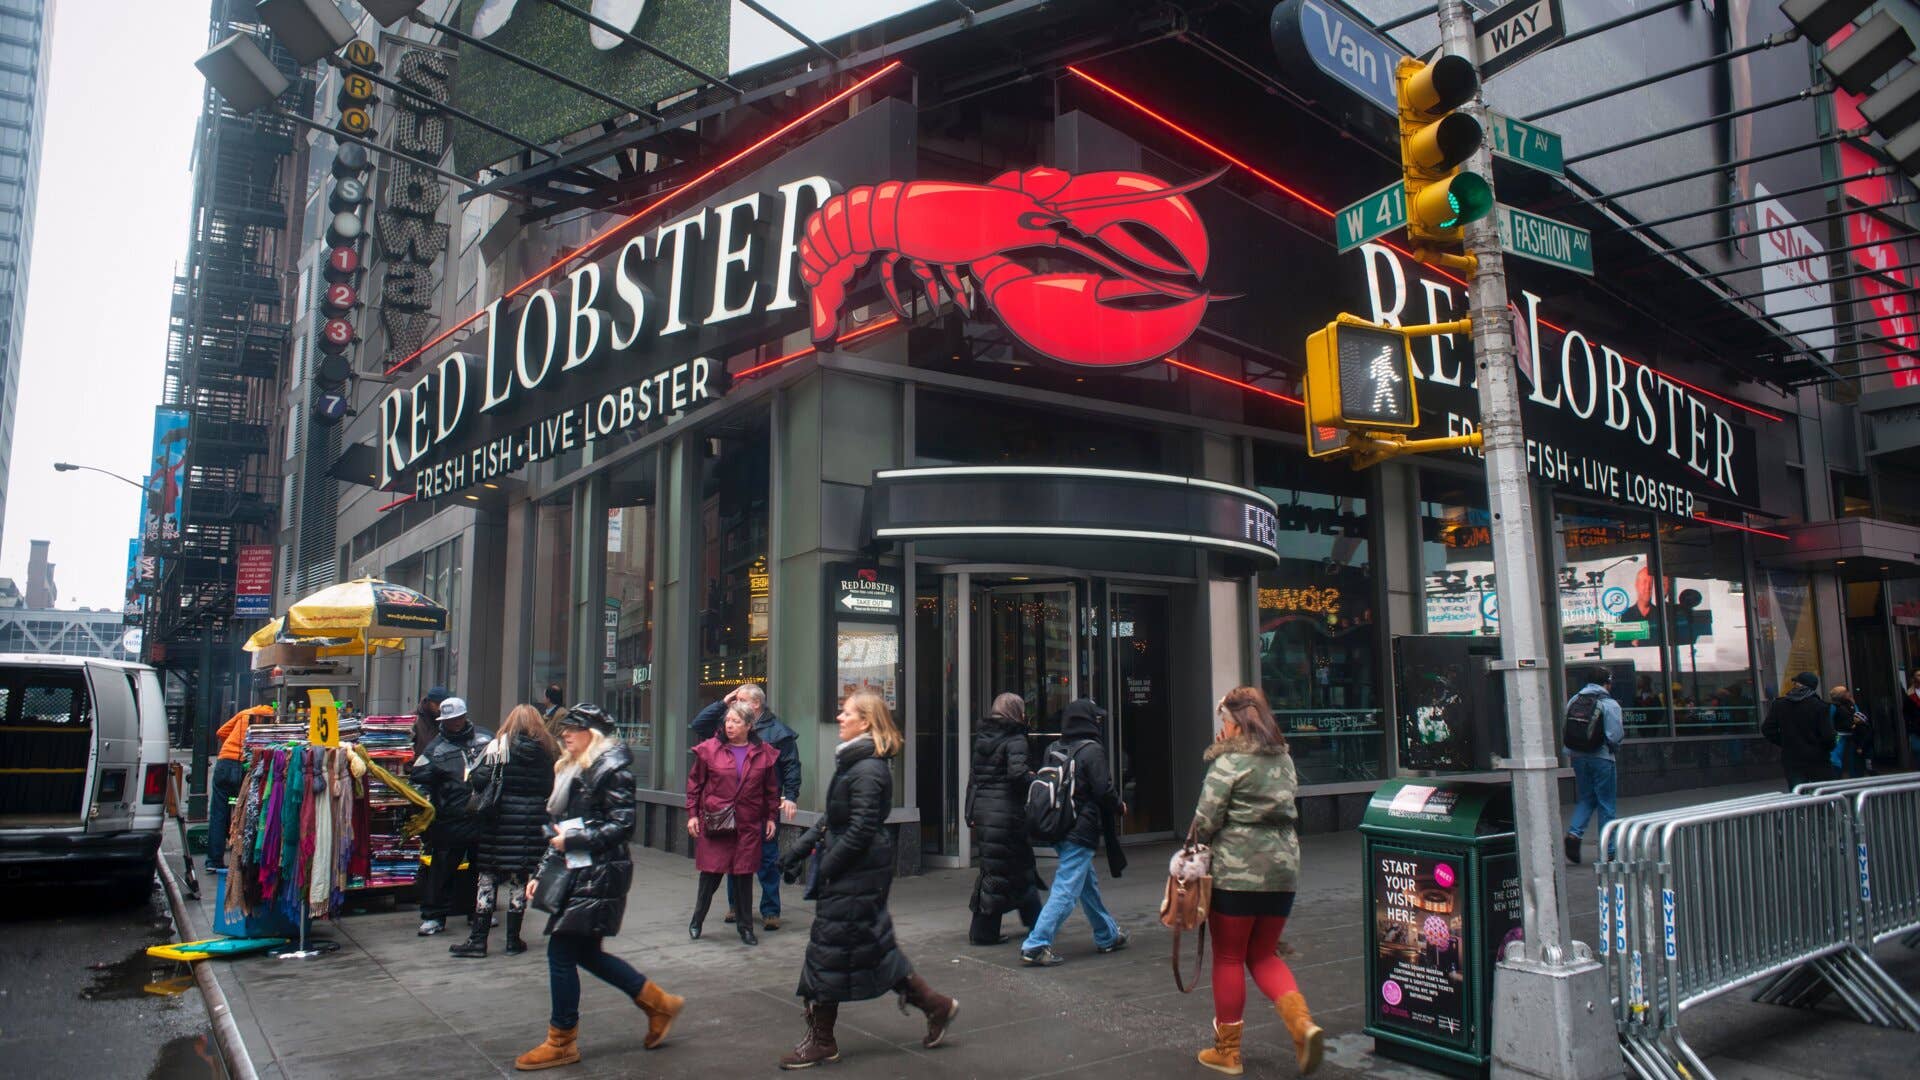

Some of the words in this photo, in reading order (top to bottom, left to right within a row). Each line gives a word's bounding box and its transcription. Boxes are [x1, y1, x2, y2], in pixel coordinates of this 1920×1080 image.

[1491, 6, 1540, 53] WAY
[1308, 4, 1377, 84] Van
[353, 46, 370, 62] N
[350, 77, 365, 95] R
[346, 112, 365, 131] Q
[1512, 124, 1529, 159] 7
[1534, 132, 1549, 153] AV
[342, 182, 359, 198] S
[1345, 208, 1364, 243] W
[1376, 189, 1402, 226] 41
[1514, 213, 1572, 263] FASHION
[1573, 230, 1588, 252] AV
[1765, 207, 1824, 288] GNC
[337, 251, 348, 269] 1
[334, 286, 349, 306] 2
[331, 322, 347, 341] 3
[378, 350, 467, 490] RED
[479, 175, 832, 414] LOBSTER
[1360, 243, 1480, 392] RE
[1521, 289, 1739, 497] LOBSTER
[325, 395, 341, 414] 7
[415, 457, 465, 502] FRESH
[472, 433, 512, 483] FISH
[528, 409, 575, 463] LIVE
[584, 356, 710, 442] LOBSTER
[1527, 438, 1570, 483] FISH
[1582, 460, 1620, 499] LIVE
[1625, 472, 1695, 520] LOBSTER
[841, 580, 859, 591] RED
[860, 580, 896, 594] LOBSTER
[1290, 716, 1313, 729] LIVE
[1318, 714, 1358, 728] LOBSTER
[1382, 859, 1418, 876] START
[1857, 846, 1869, 898] NYPD
[1384, 874, 1416, 891] YOUR
[1502, 878, 1520, 889] COME
[1386, 891, 1416, 908] VISIT
[1493, 890, 1504, 900] THE
[1506, 888, 1520, 898] CENT
[1387, 907, 1417, 924] HERE
[1493, 901, 1506, 912] NEW
[1615, 887, 1626, 950] NYPD
[1663, 892, 1676, 957] NYPD
